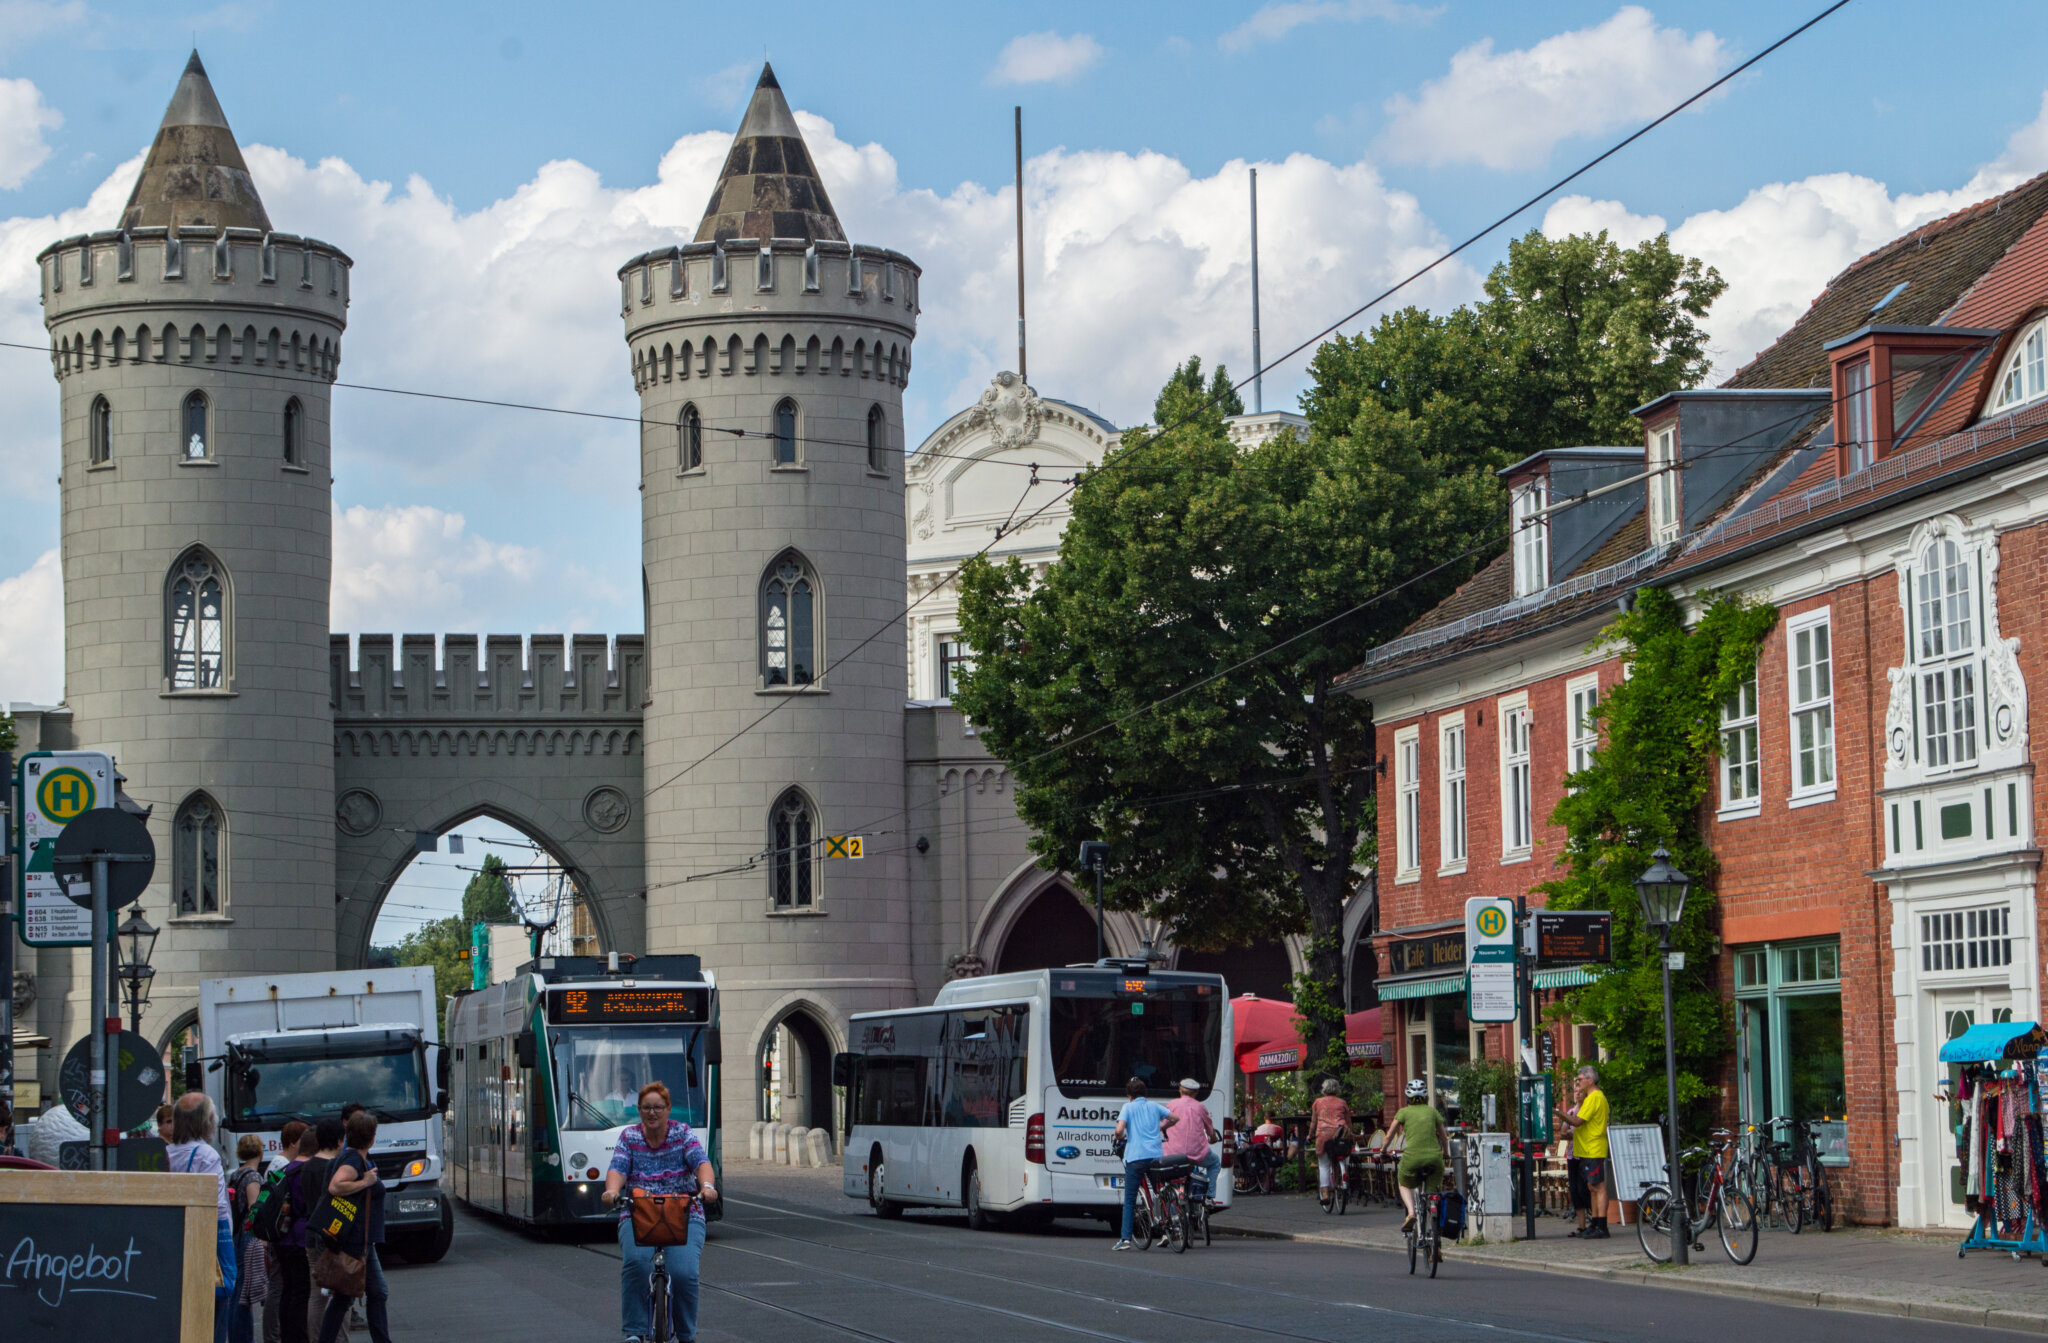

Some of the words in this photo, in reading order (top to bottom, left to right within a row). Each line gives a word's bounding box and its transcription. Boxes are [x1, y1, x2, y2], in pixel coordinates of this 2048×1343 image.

[52, 780, 80, 812] H
[850, 840, 860, 856] 2
[1484, 913, 1499, 931] H
[1406, 943, 1425, 968] Café
[1432, 939, 1464, 964] Heider
[566, 991, 589, 1013] 92
[1346, 1044, 1383, 1057] RAMAZZOT
[1057, 1106, 1120, 1120] Autoha
[1056, 1131, 1116, 1143] Allradkomp
[1085, 1148, 1117, 1157] SUBA
[330, 1198, 355, 1222] WISSEN
[6, 1235, 142, 1308] Angebot
